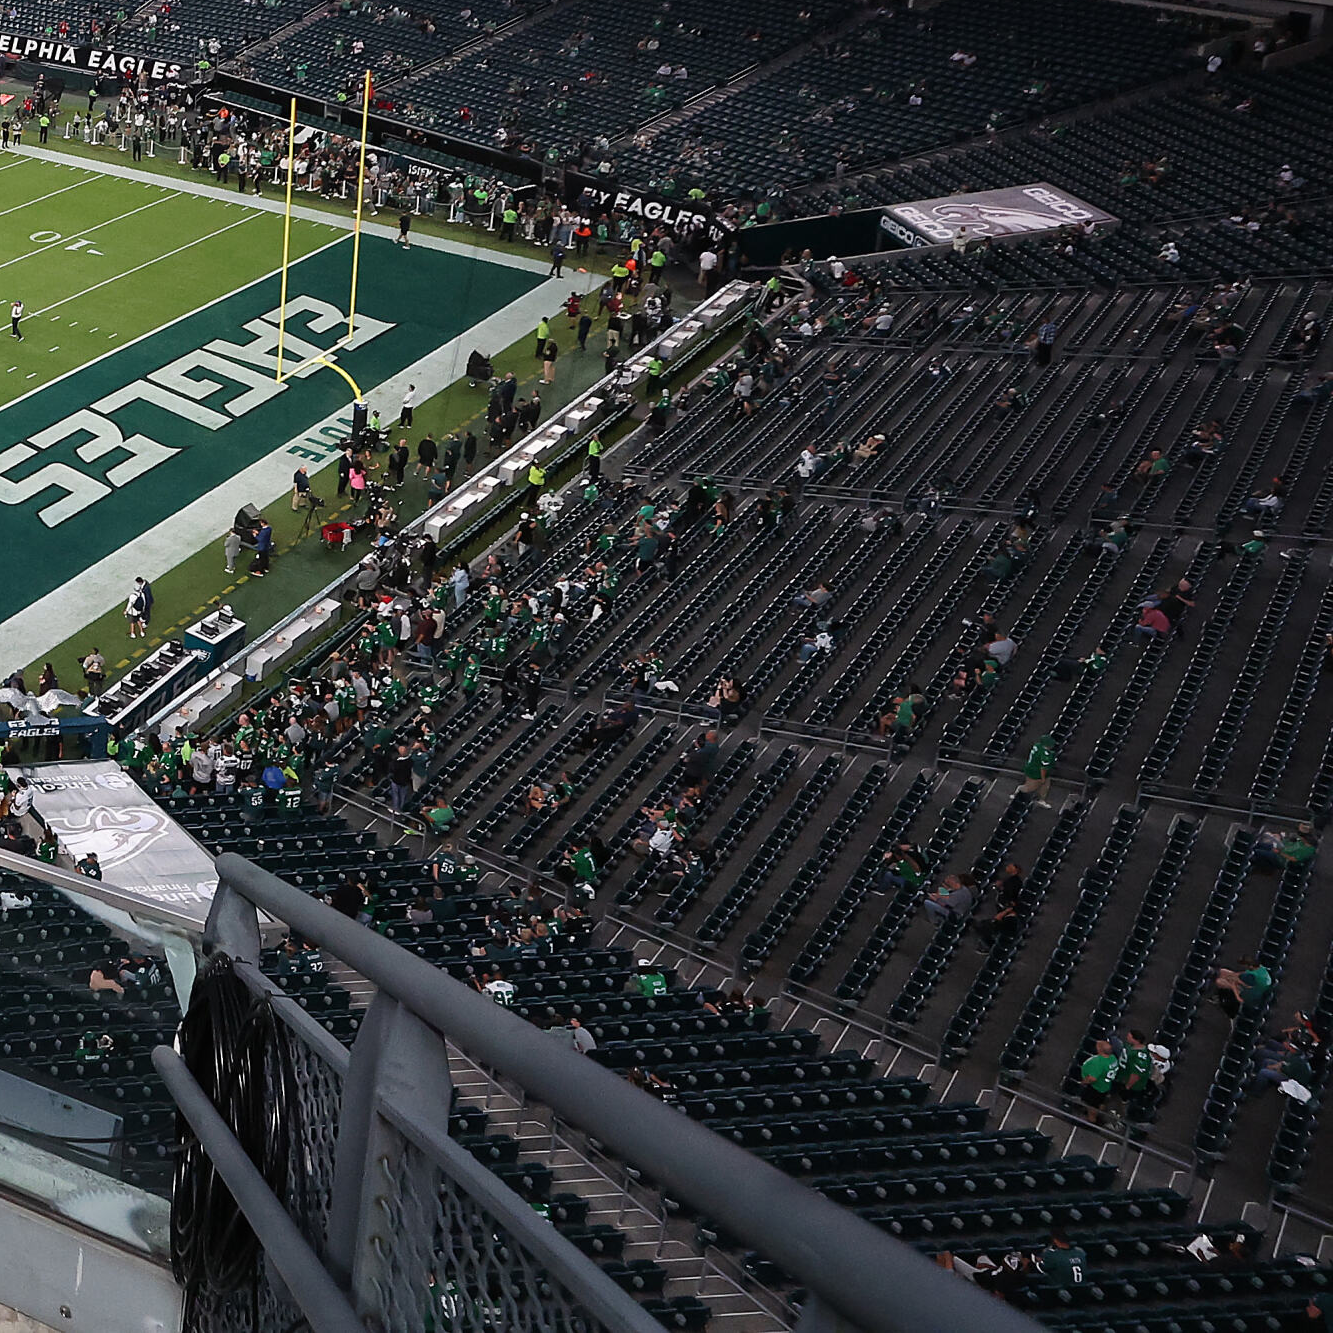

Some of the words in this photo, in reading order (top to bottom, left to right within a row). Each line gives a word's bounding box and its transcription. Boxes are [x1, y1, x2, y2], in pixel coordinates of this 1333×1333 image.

[1023, 187, 1093, 220] GEICO
[880, 216, 916, 244] GEICO
[893, 207, 954, 239] GEICO
[9, 727, 61, 739] EAGLES
[34, 780, 100, 794] Lincol
[286, 796, 301, 808] 12
[1071, 1265, 1083, 1283] 6
